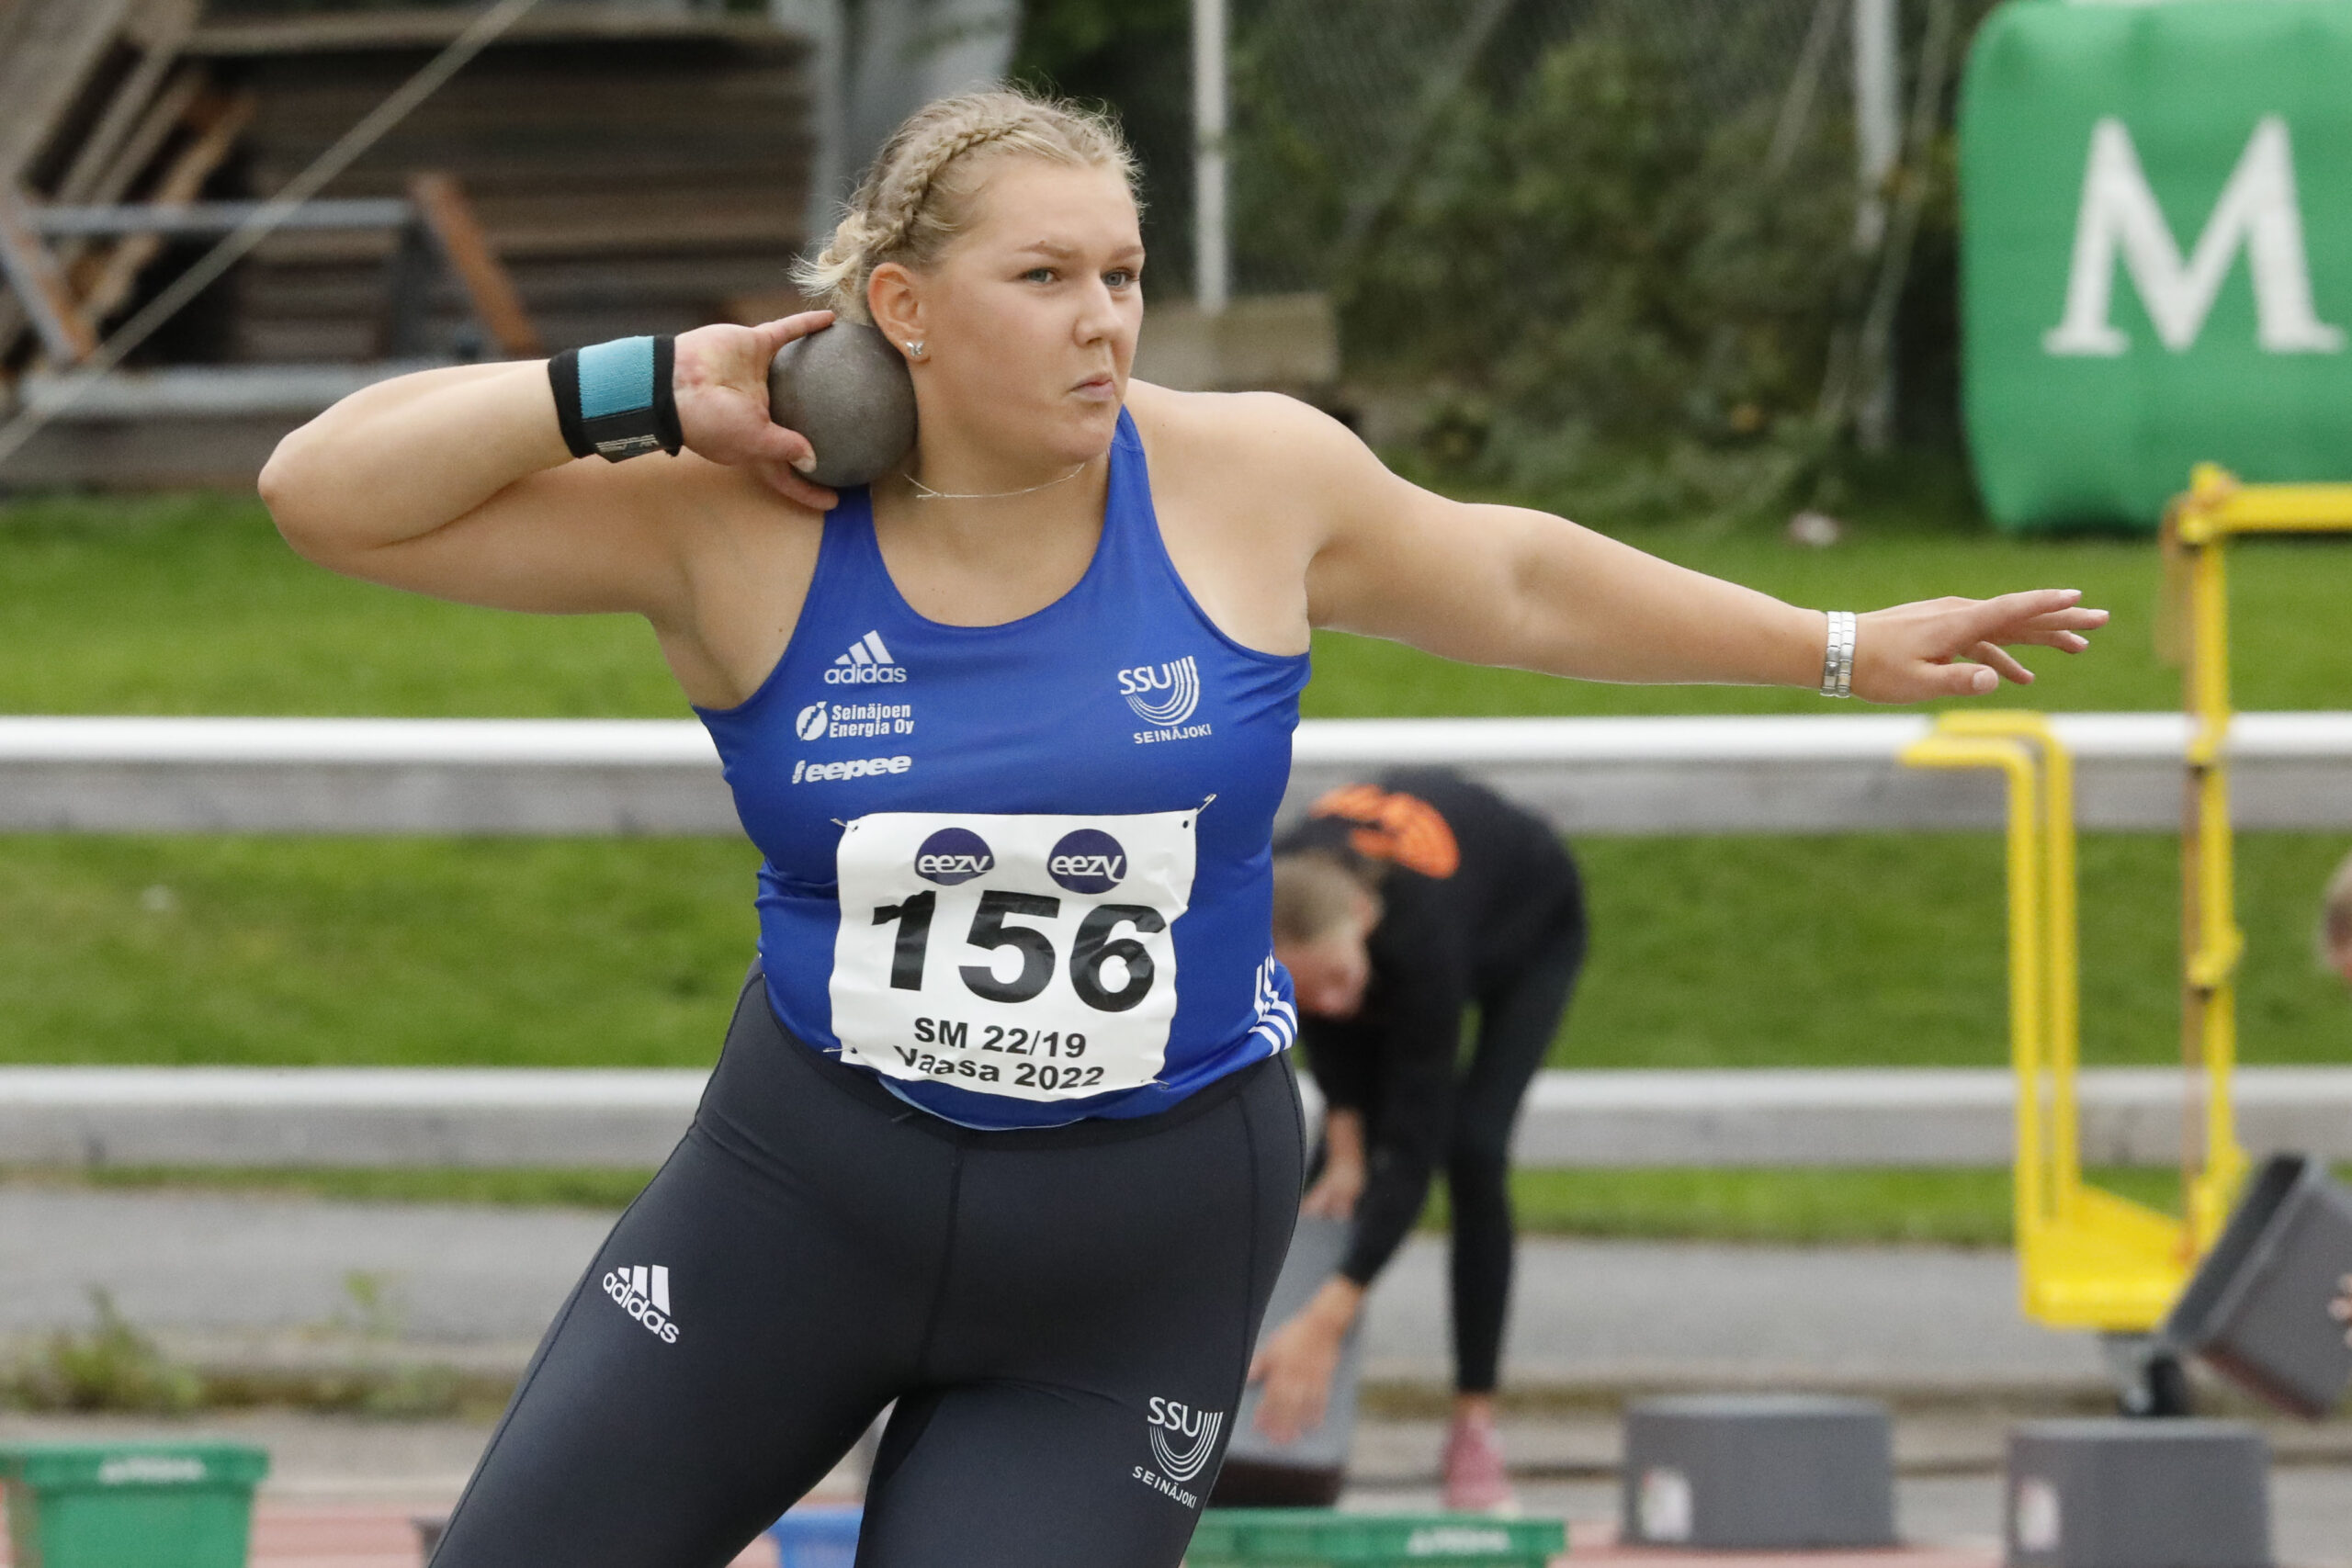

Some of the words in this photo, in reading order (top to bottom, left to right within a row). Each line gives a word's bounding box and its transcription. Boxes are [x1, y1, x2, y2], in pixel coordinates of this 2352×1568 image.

[2042, 114, 2346, 357] M
[824, 662, 908, 683] adidas
[1117, 663, 1172, 695] SSU
[830, 719, 891, 738] Energia
[894, 718, 915, 735] Oy
[831, 703, 911, 722] Seinäjoen
[1133, 723, 1212, 744] SEINÄJOKI
[919, 854, 991, 874] eezy
[1050, 855, 1125, 883] eezy
[872, 889, 1167, 1013] 156
[914, 1017, 968, 1049] SM
[982, 1024, 1087, 1058] 22/19
[893, 1045, 1000, 1082] Vaasa
[1014, 1063, 1105, 1090] 2022
[603, 1272, 680, 1344] adidas
[1147, 1396, 1203, 1438] SSU
[1132, 1465, 1198, 1509] SEINÄJOKI
